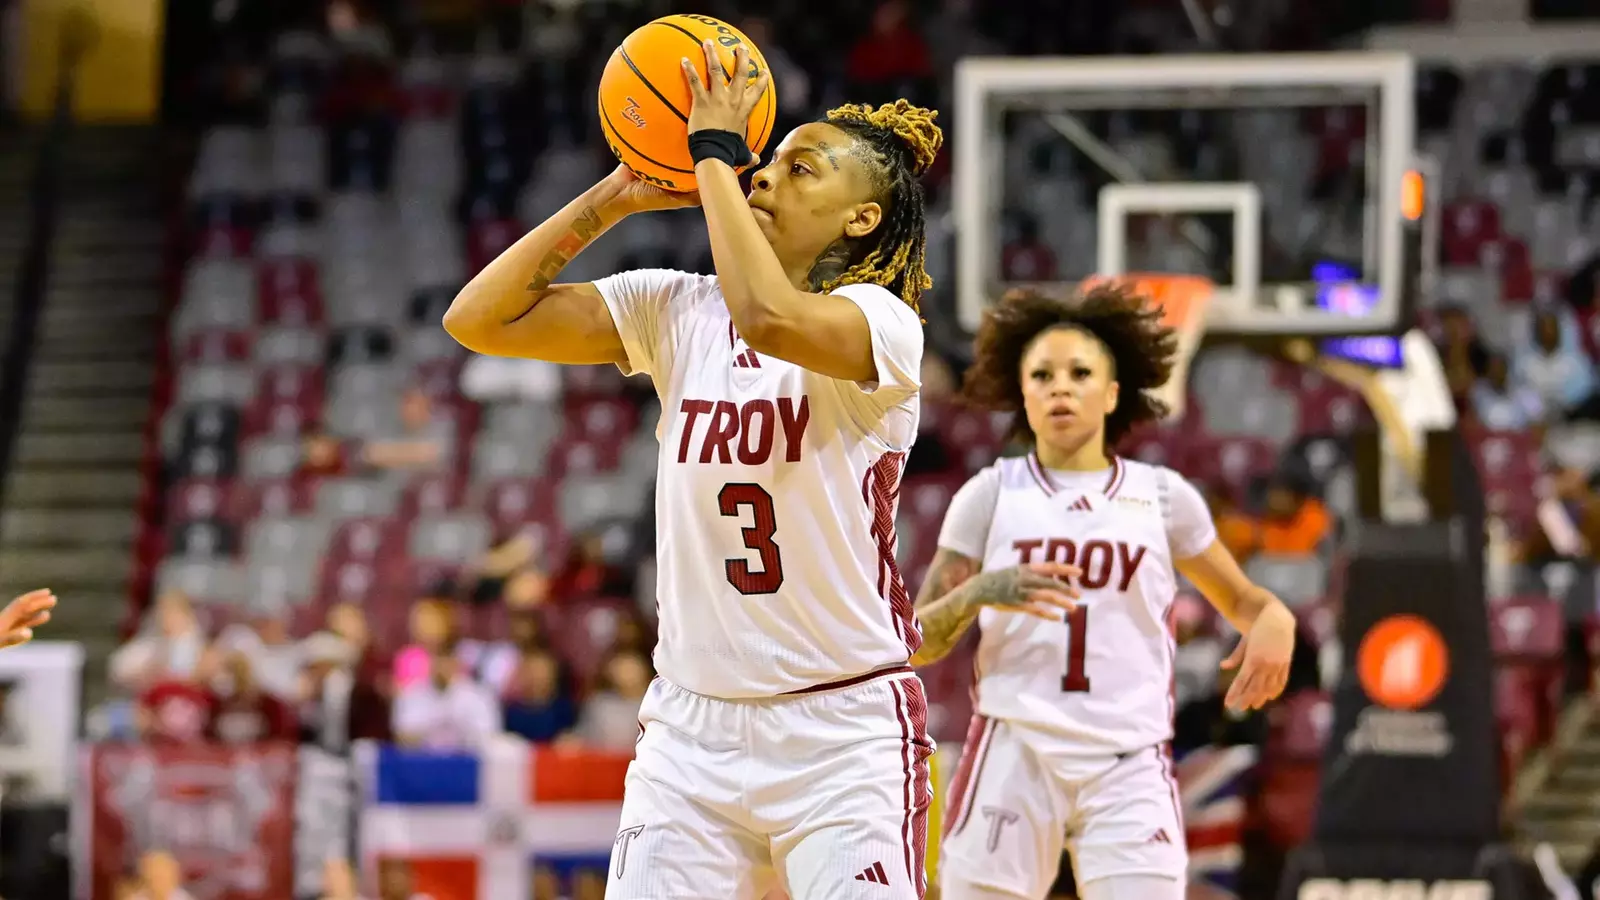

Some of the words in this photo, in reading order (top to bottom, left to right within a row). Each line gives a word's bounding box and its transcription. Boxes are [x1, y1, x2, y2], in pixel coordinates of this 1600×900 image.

[621, 96, 647, 128] Troy
[677, 394, 810, 466] TROY
[717, 482, 784, 595] 3
[1011, 537, 1147, 592] TROY
[1061, 604, 1090, 693] 1
